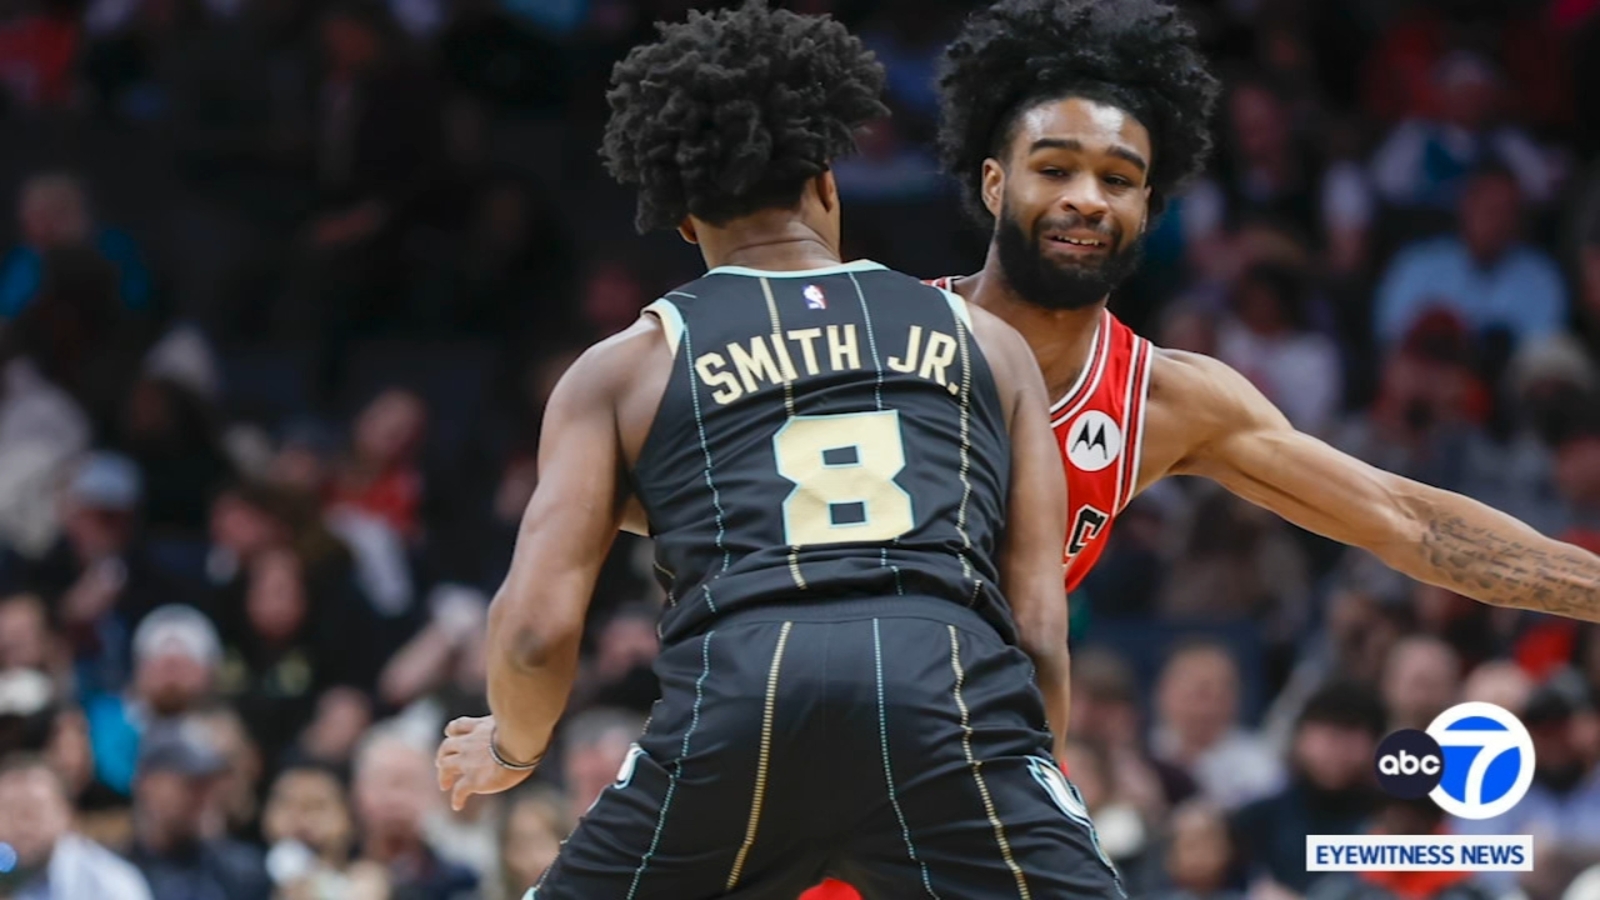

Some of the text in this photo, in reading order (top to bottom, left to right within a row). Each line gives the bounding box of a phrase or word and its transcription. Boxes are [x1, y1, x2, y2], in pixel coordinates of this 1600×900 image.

[694, 324, 959, 405] SMITH JR.
[772, 409, 914, 546] 8
